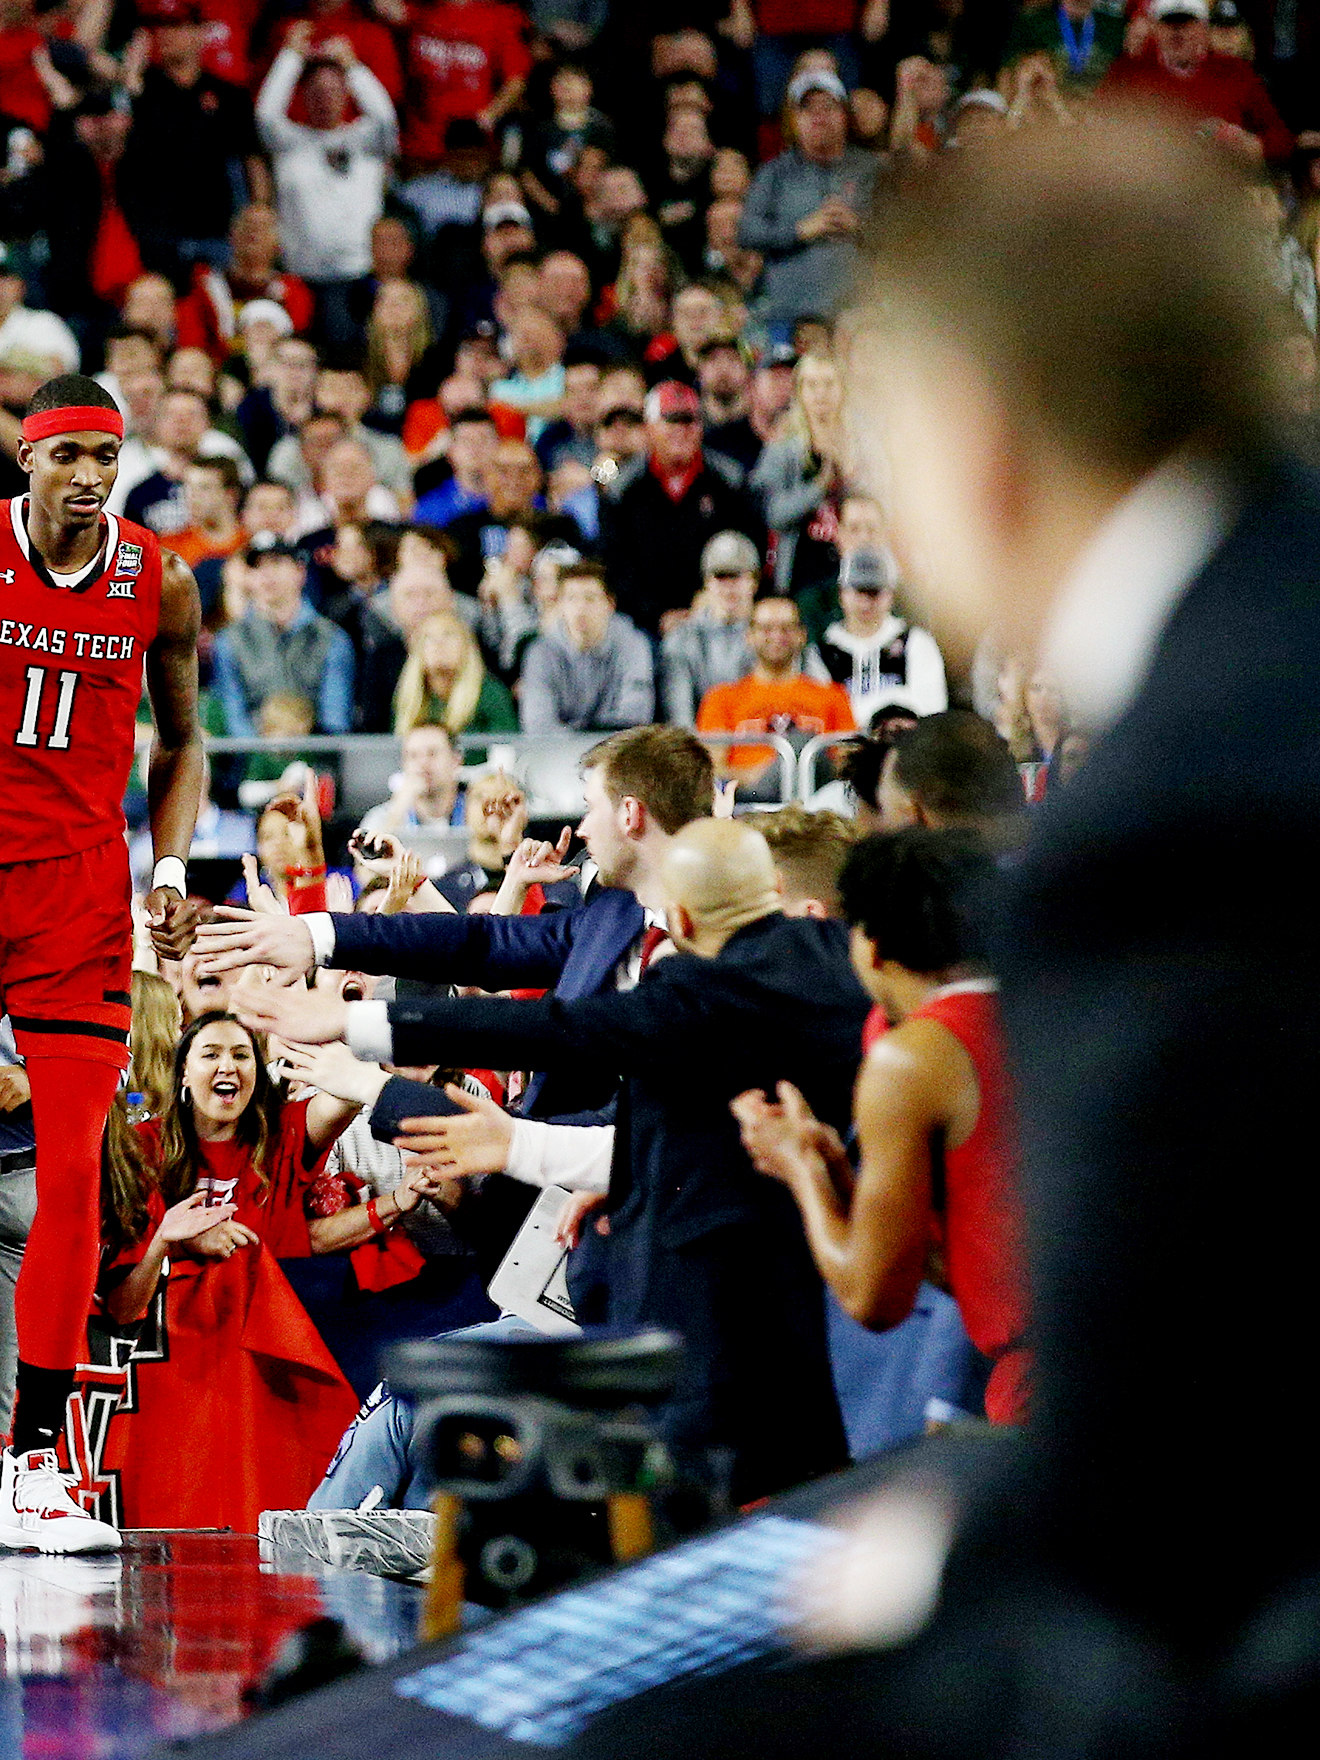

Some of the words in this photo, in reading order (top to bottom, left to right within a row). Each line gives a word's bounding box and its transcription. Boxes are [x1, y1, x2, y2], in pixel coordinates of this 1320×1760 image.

[106, 581, 136, 598] XII
[73, 631, 135, 660] TECH
[15, 666, 78, 749] 11
